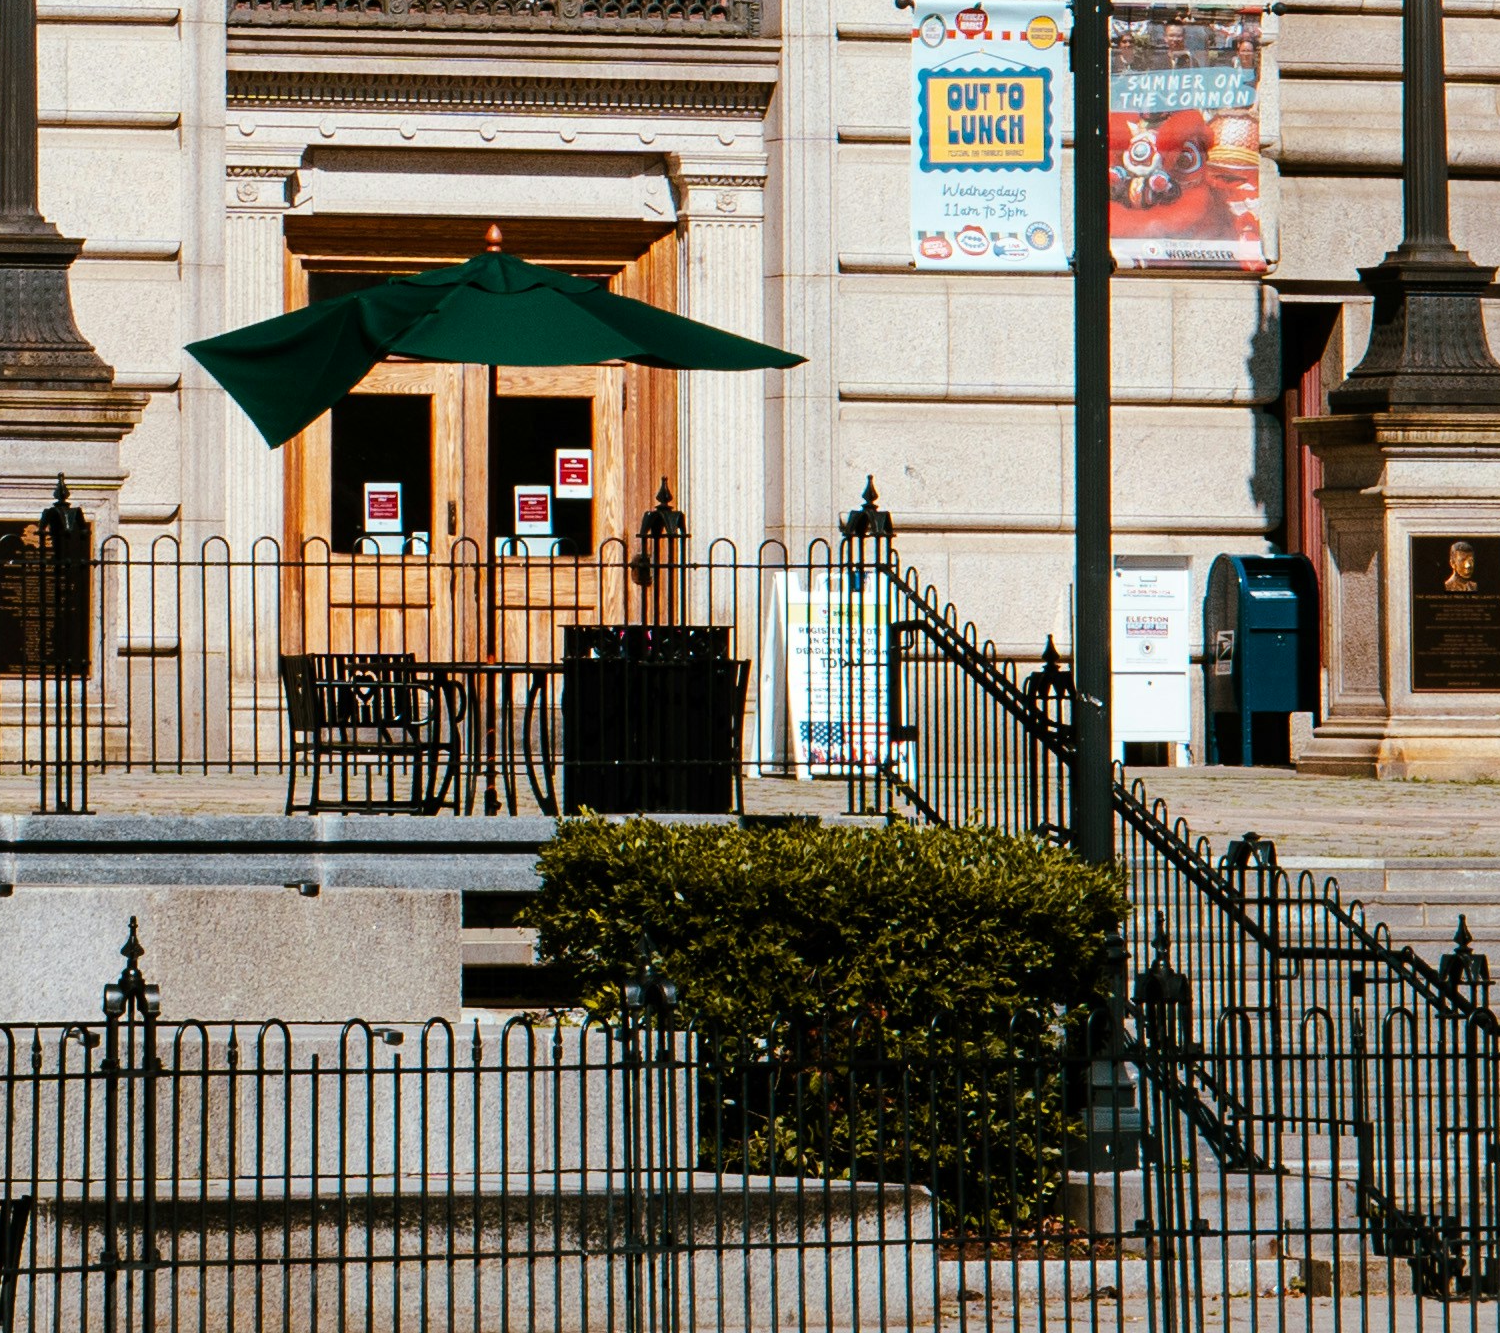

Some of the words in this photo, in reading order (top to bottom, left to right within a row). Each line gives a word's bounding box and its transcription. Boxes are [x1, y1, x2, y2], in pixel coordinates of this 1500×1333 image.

[1127, 73, 1205, 91] SUMMER
[1214, 73, 1243, 89] ON
[947, 83, 991, 111] OUT
[996, 82, 1025, 111] TO
[1119, 91, 1157, 109] THE
[1165, 90, 1250, 107] COMMON
[947, 115, 1025, 145] LUNCH
[942, 183, 1027, 203] Wednesdays
[943, 202, 981, 217] 11am
[983, 204, 997, 219] to
[998, 203, 1029, 221] 3pm
